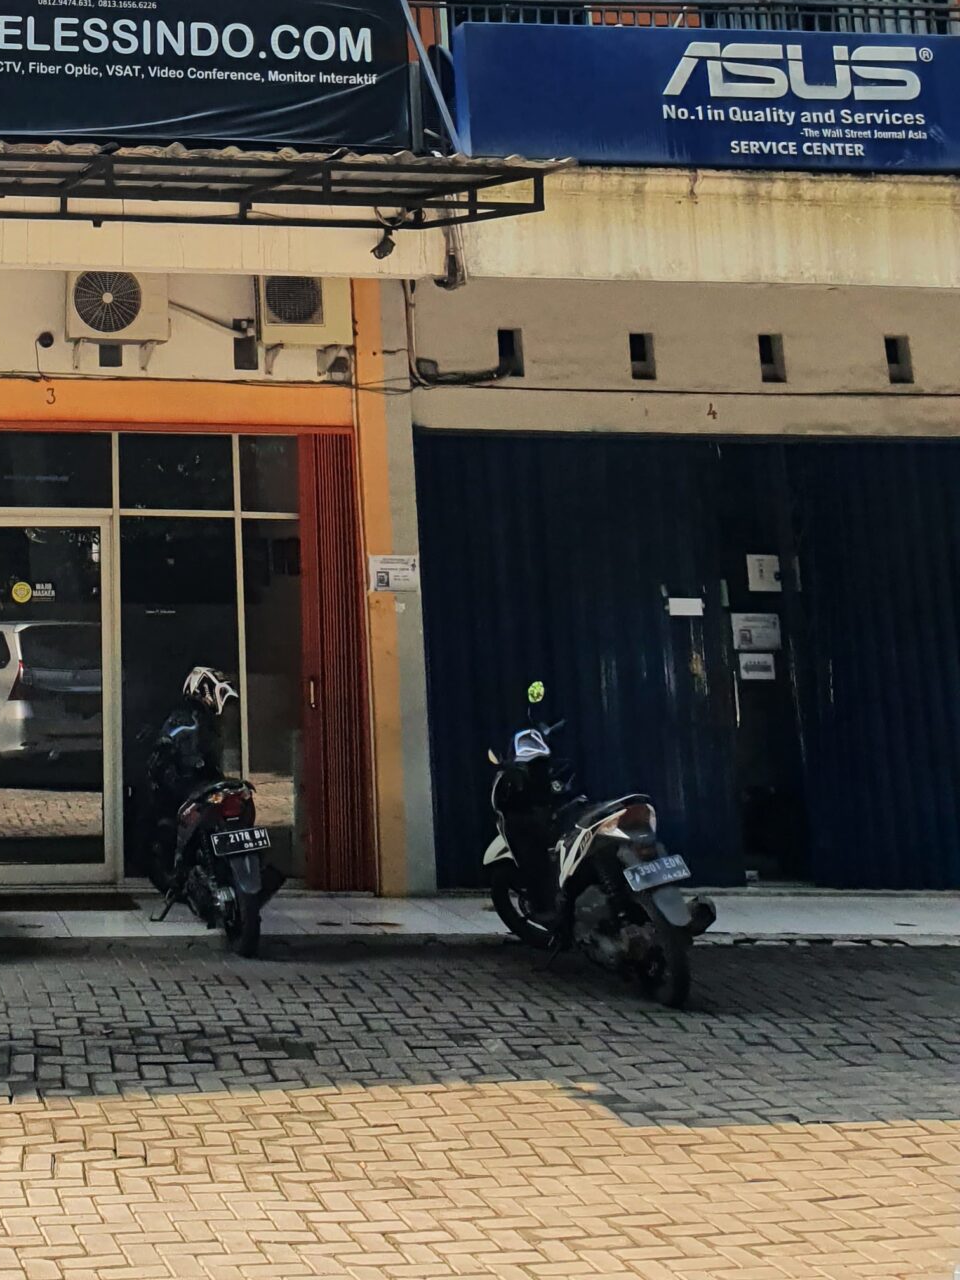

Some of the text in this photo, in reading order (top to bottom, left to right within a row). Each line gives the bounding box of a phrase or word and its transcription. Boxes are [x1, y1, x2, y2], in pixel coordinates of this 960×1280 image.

[29, 62, 61, 75] Fiber
[66, 63, 102, 77] Optic,
[106, 64, 145, 79] VSAT,
[148, 66, 184, 79] Video
[187, 67, 265, 83] Conference,
[268, 70, 315, 83] Monitor
[319, 71, 377, 85] Interaktif
[662, 41, 921, 101] ASUS
[729, 106, 795, 125] Quality
[801, 109, 835, 124] and
[841, 109, 925, 125] Services
[822, 128, 843, 138] Wall
[845, 129, 871, 139] Street
[874, 130, 906, 140] Journal
[908, 131, 927, 140] Asia
[730, 141, 864, 156] SERVICE CENTER
[46, 388, 56, 405] 3
[213, 835, 219, 845] F
